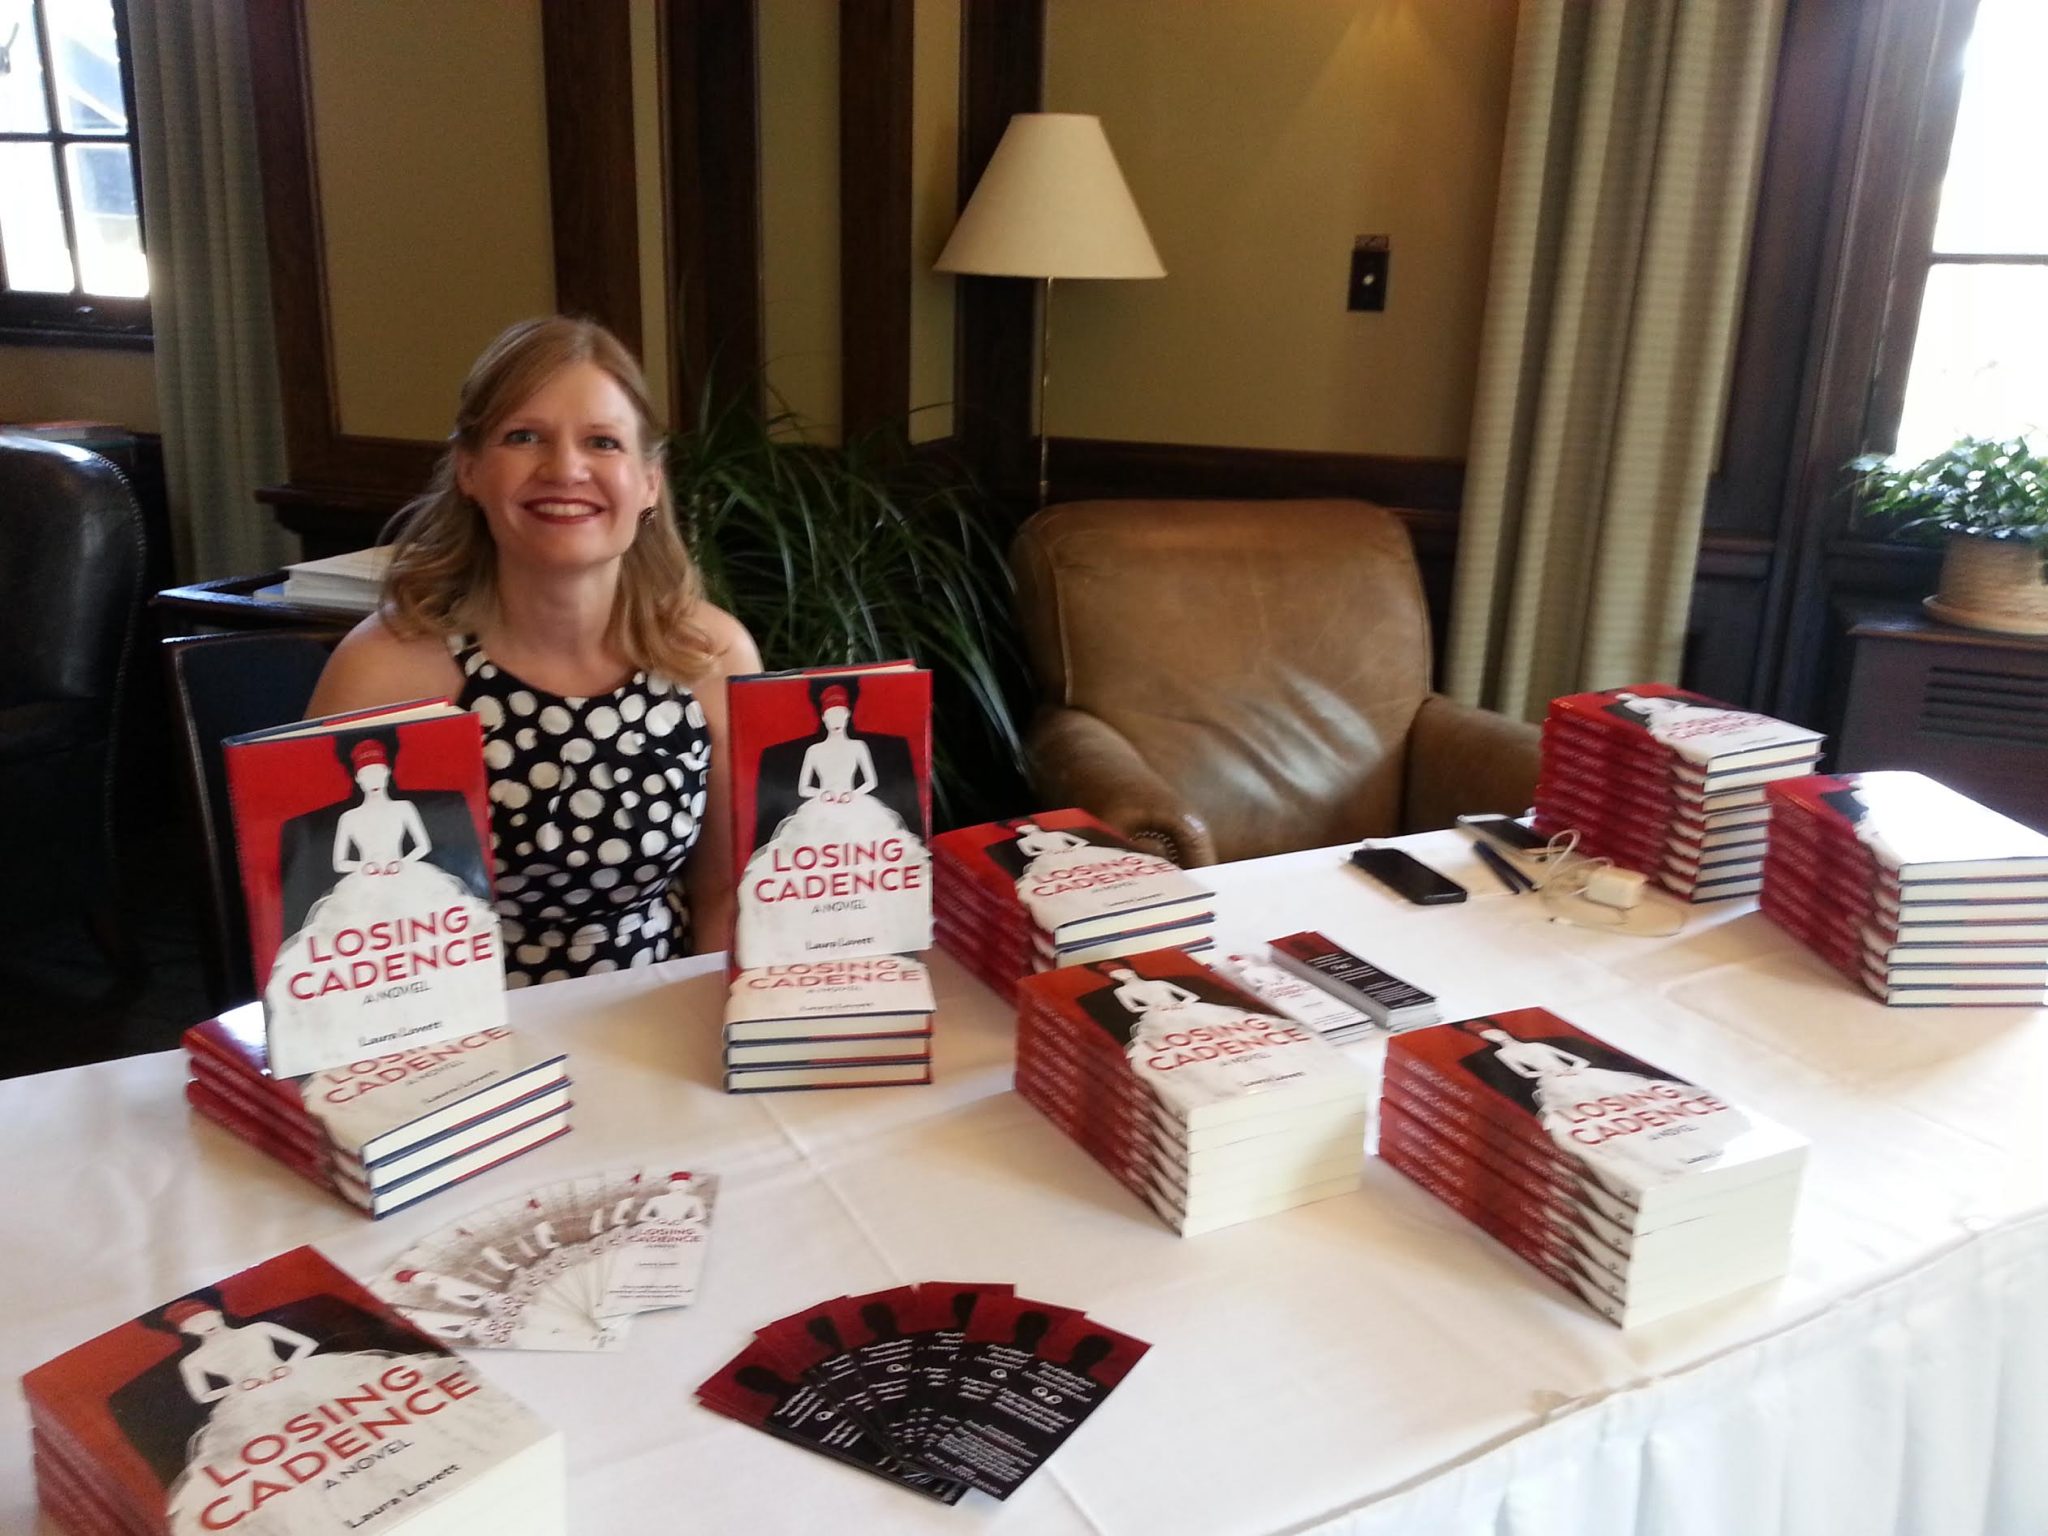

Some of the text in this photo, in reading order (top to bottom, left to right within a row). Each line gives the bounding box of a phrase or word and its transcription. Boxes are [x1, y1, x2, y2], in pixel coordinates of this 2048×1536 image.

[773, 838, 903, 873] LOSING
[1032, 856, 1142, 884] LOSING
[754, 865, 922, 903] CADENCE
[1032, 862, 1176, 896] CADENCE
[307, 905, 470, 964] LOSING
[288, 931, 495, 1000] CADENCE
[748, 969, 922, 989] CADENCE
[767, 959, 899, 977] LOSING
[376, 980, 432, 1000] NOVEL
[1147, 1017, 1270, 1053] LOSING
[1149, 1028, 1312, 1071] CADENCE
[325, 1025, 513, 1103] CADENCE
[1564, 1085, 1681, 1124] LOSING
[1568, 1095, 1729, 1146] CADENCE
[202, 1365, 421, 1488] LOSING
[199, 1371, 482, 1532] CADENCE
[324, 1439, 415, 1491] A NOVEL
[343, 1463, 462, 1529] Laura Lovett
